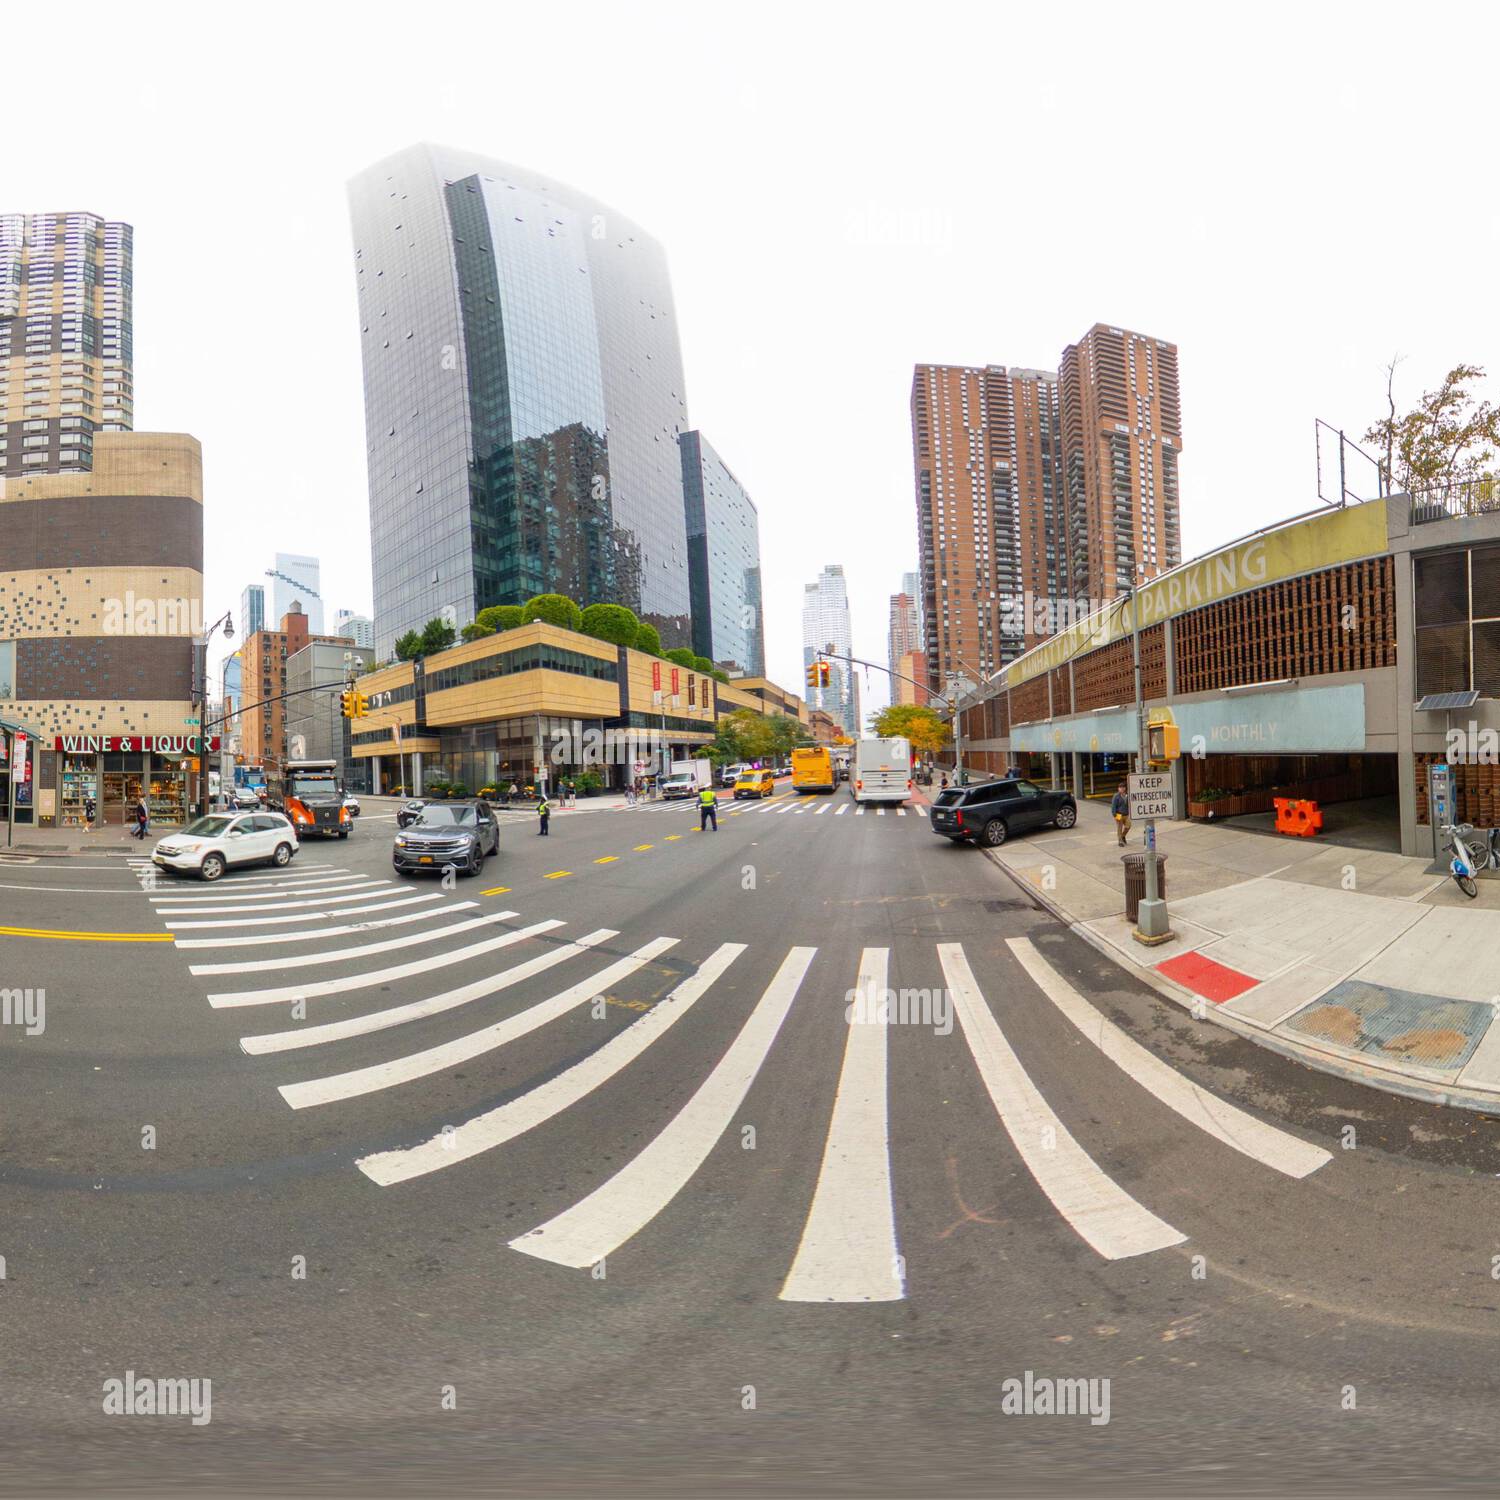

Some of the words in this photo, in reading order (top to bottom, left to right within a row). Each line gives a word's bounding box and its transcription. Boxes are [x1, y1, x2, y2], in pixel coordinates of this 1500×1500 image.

[1142, 541, 1267, 625] PARKING
[1211, 721, 1277, 742] MONTHLY
[62, 736, 111, 752] WINE
[120, 736, 131, 752] &
[1139, 778, 1162, 789] KEEP
[1131, 790, 1172, 802] INTERSECTION
[1137, 803, 1167, 815] CLEAR
